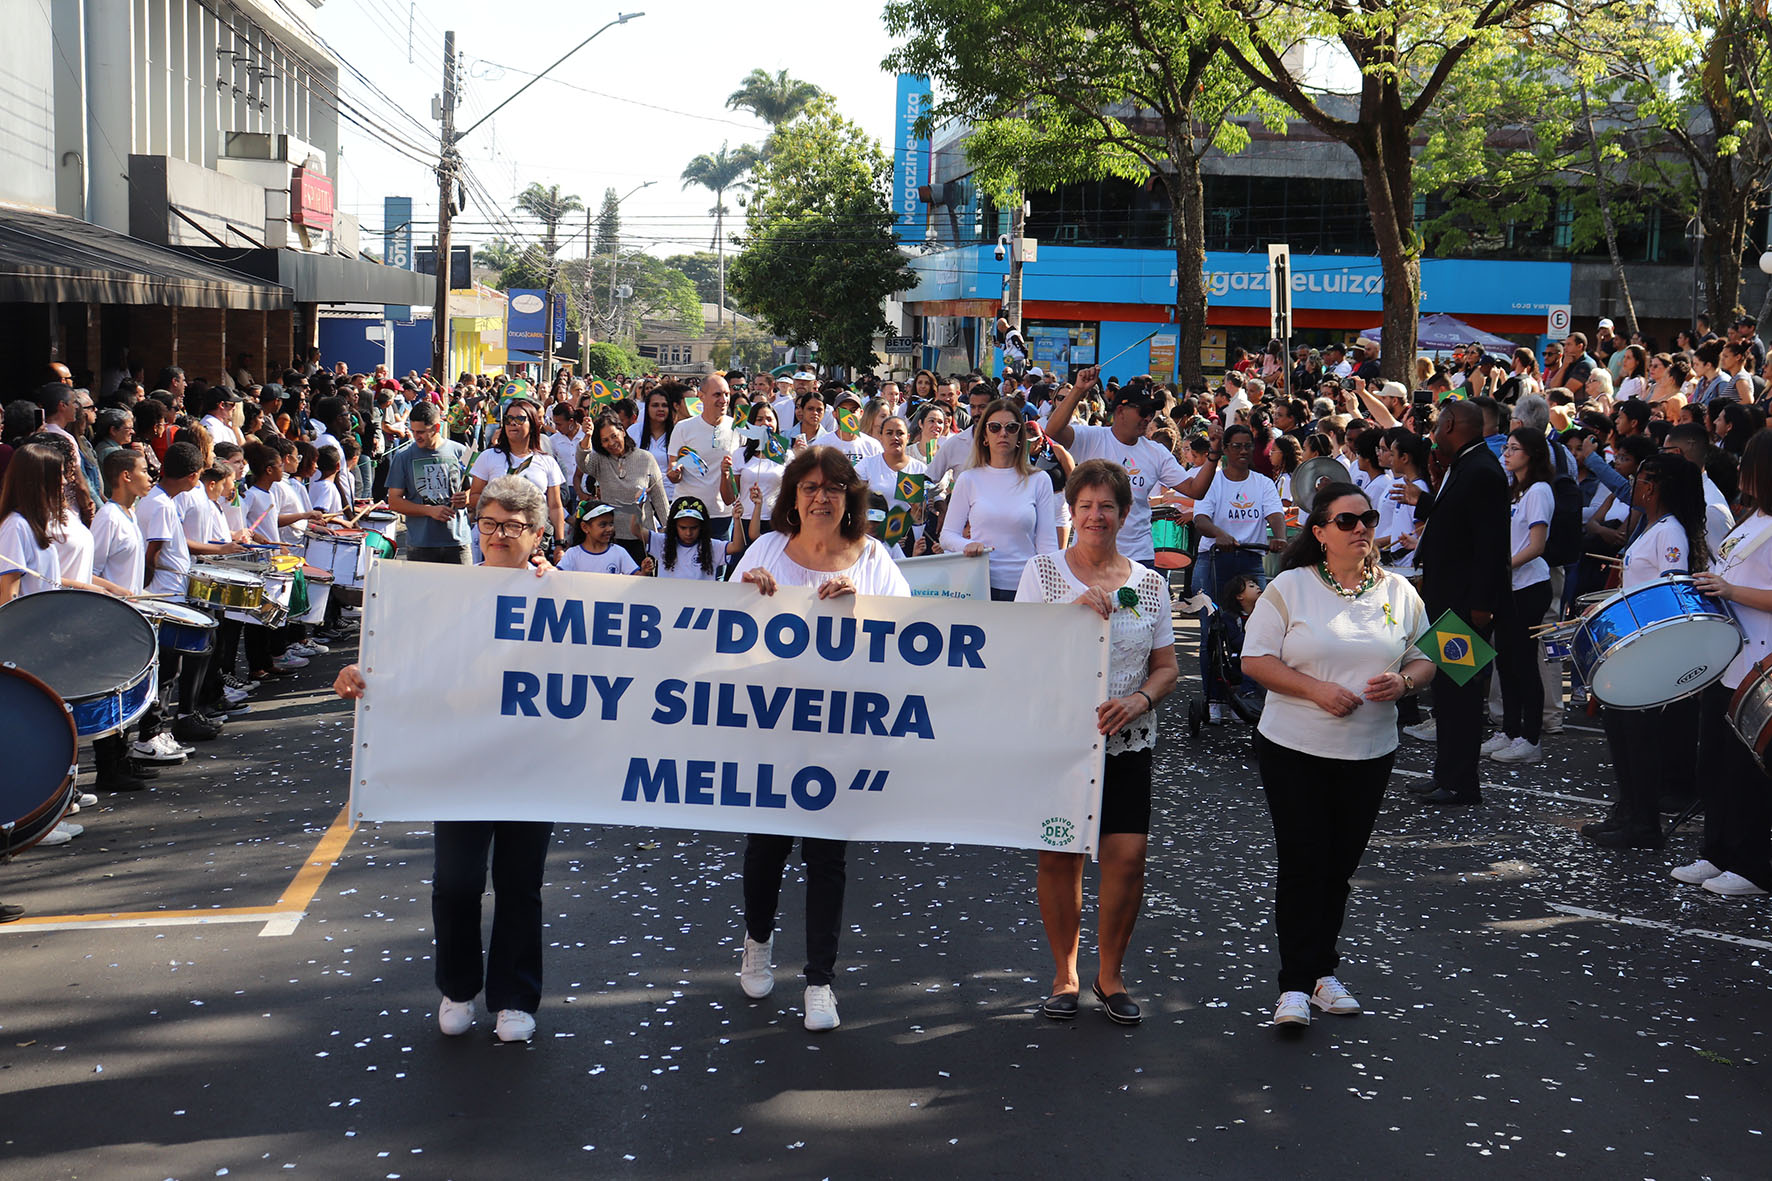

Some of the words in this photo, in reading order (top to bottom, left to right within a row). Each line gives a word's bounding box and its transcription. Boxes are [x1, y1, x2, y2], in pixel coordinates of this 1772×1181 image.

[392, 225, 407, 268] onte
[1169, 266, 1384, 297] gazieLuiza
[1556, 313, 1563, 325] E
[886, 338, 912, 347] BETO
[1228, 508, 1260, 520] AAPCD
[911, 588, 939, 597] ilveira
[494, 594, 663, 649] EMEB
[500, 670, 635, 721] RUY
[651, 678, 936, 740] SILVEIRA
[1041, 816, 1075, 830] ADESIVOS
[1045, 825, 1070, 838] DEX
